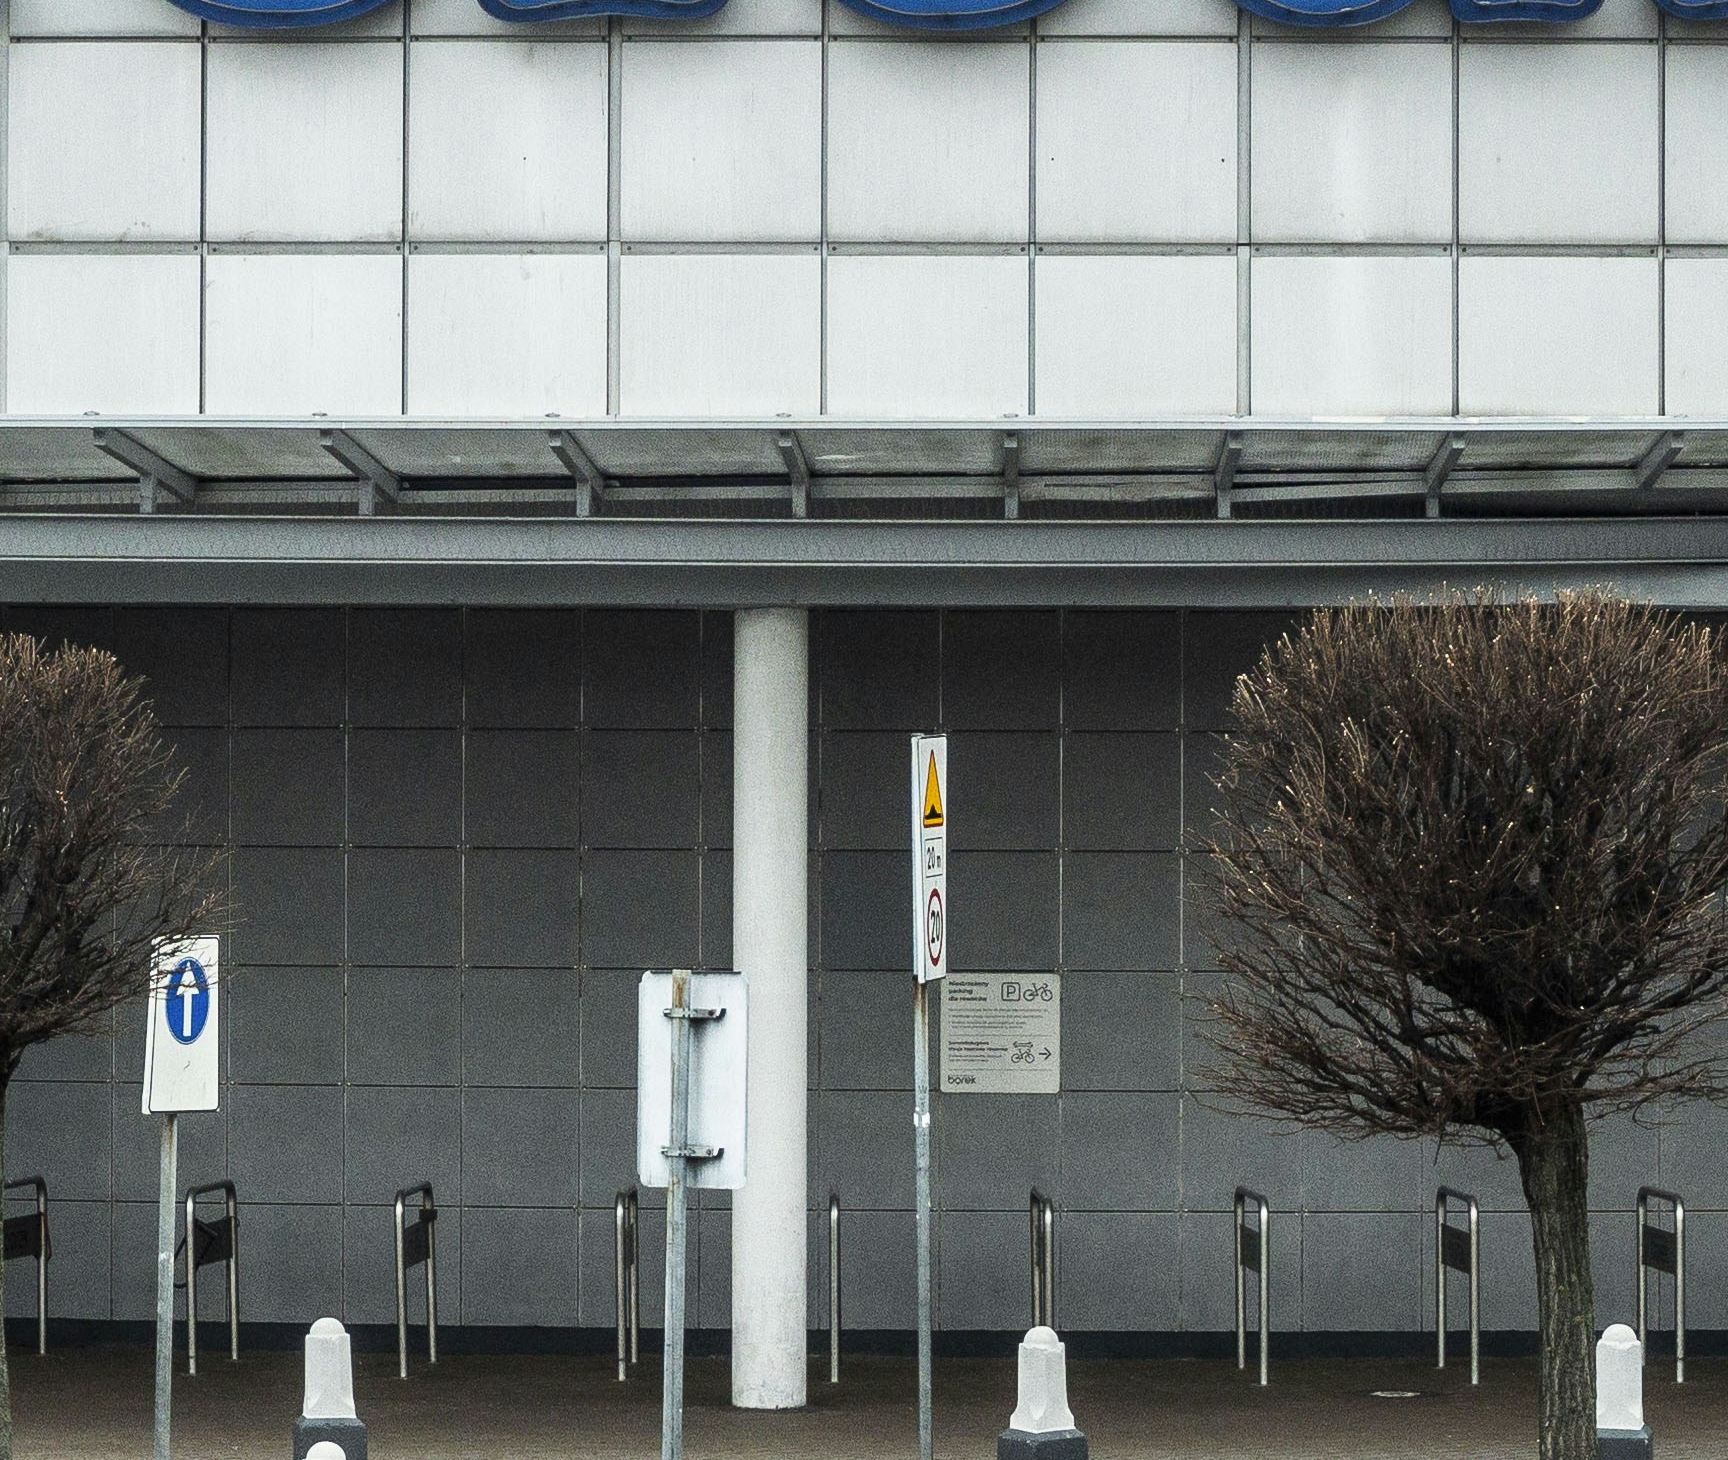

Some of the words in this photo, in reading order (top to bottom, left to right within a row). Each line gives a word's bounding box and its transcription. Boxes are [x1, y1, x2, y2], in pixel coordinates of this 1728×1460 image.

[926, 847, 936, 870] 20
[936, 854, 942, 868] m
[930, 909, 940, 943] 20
